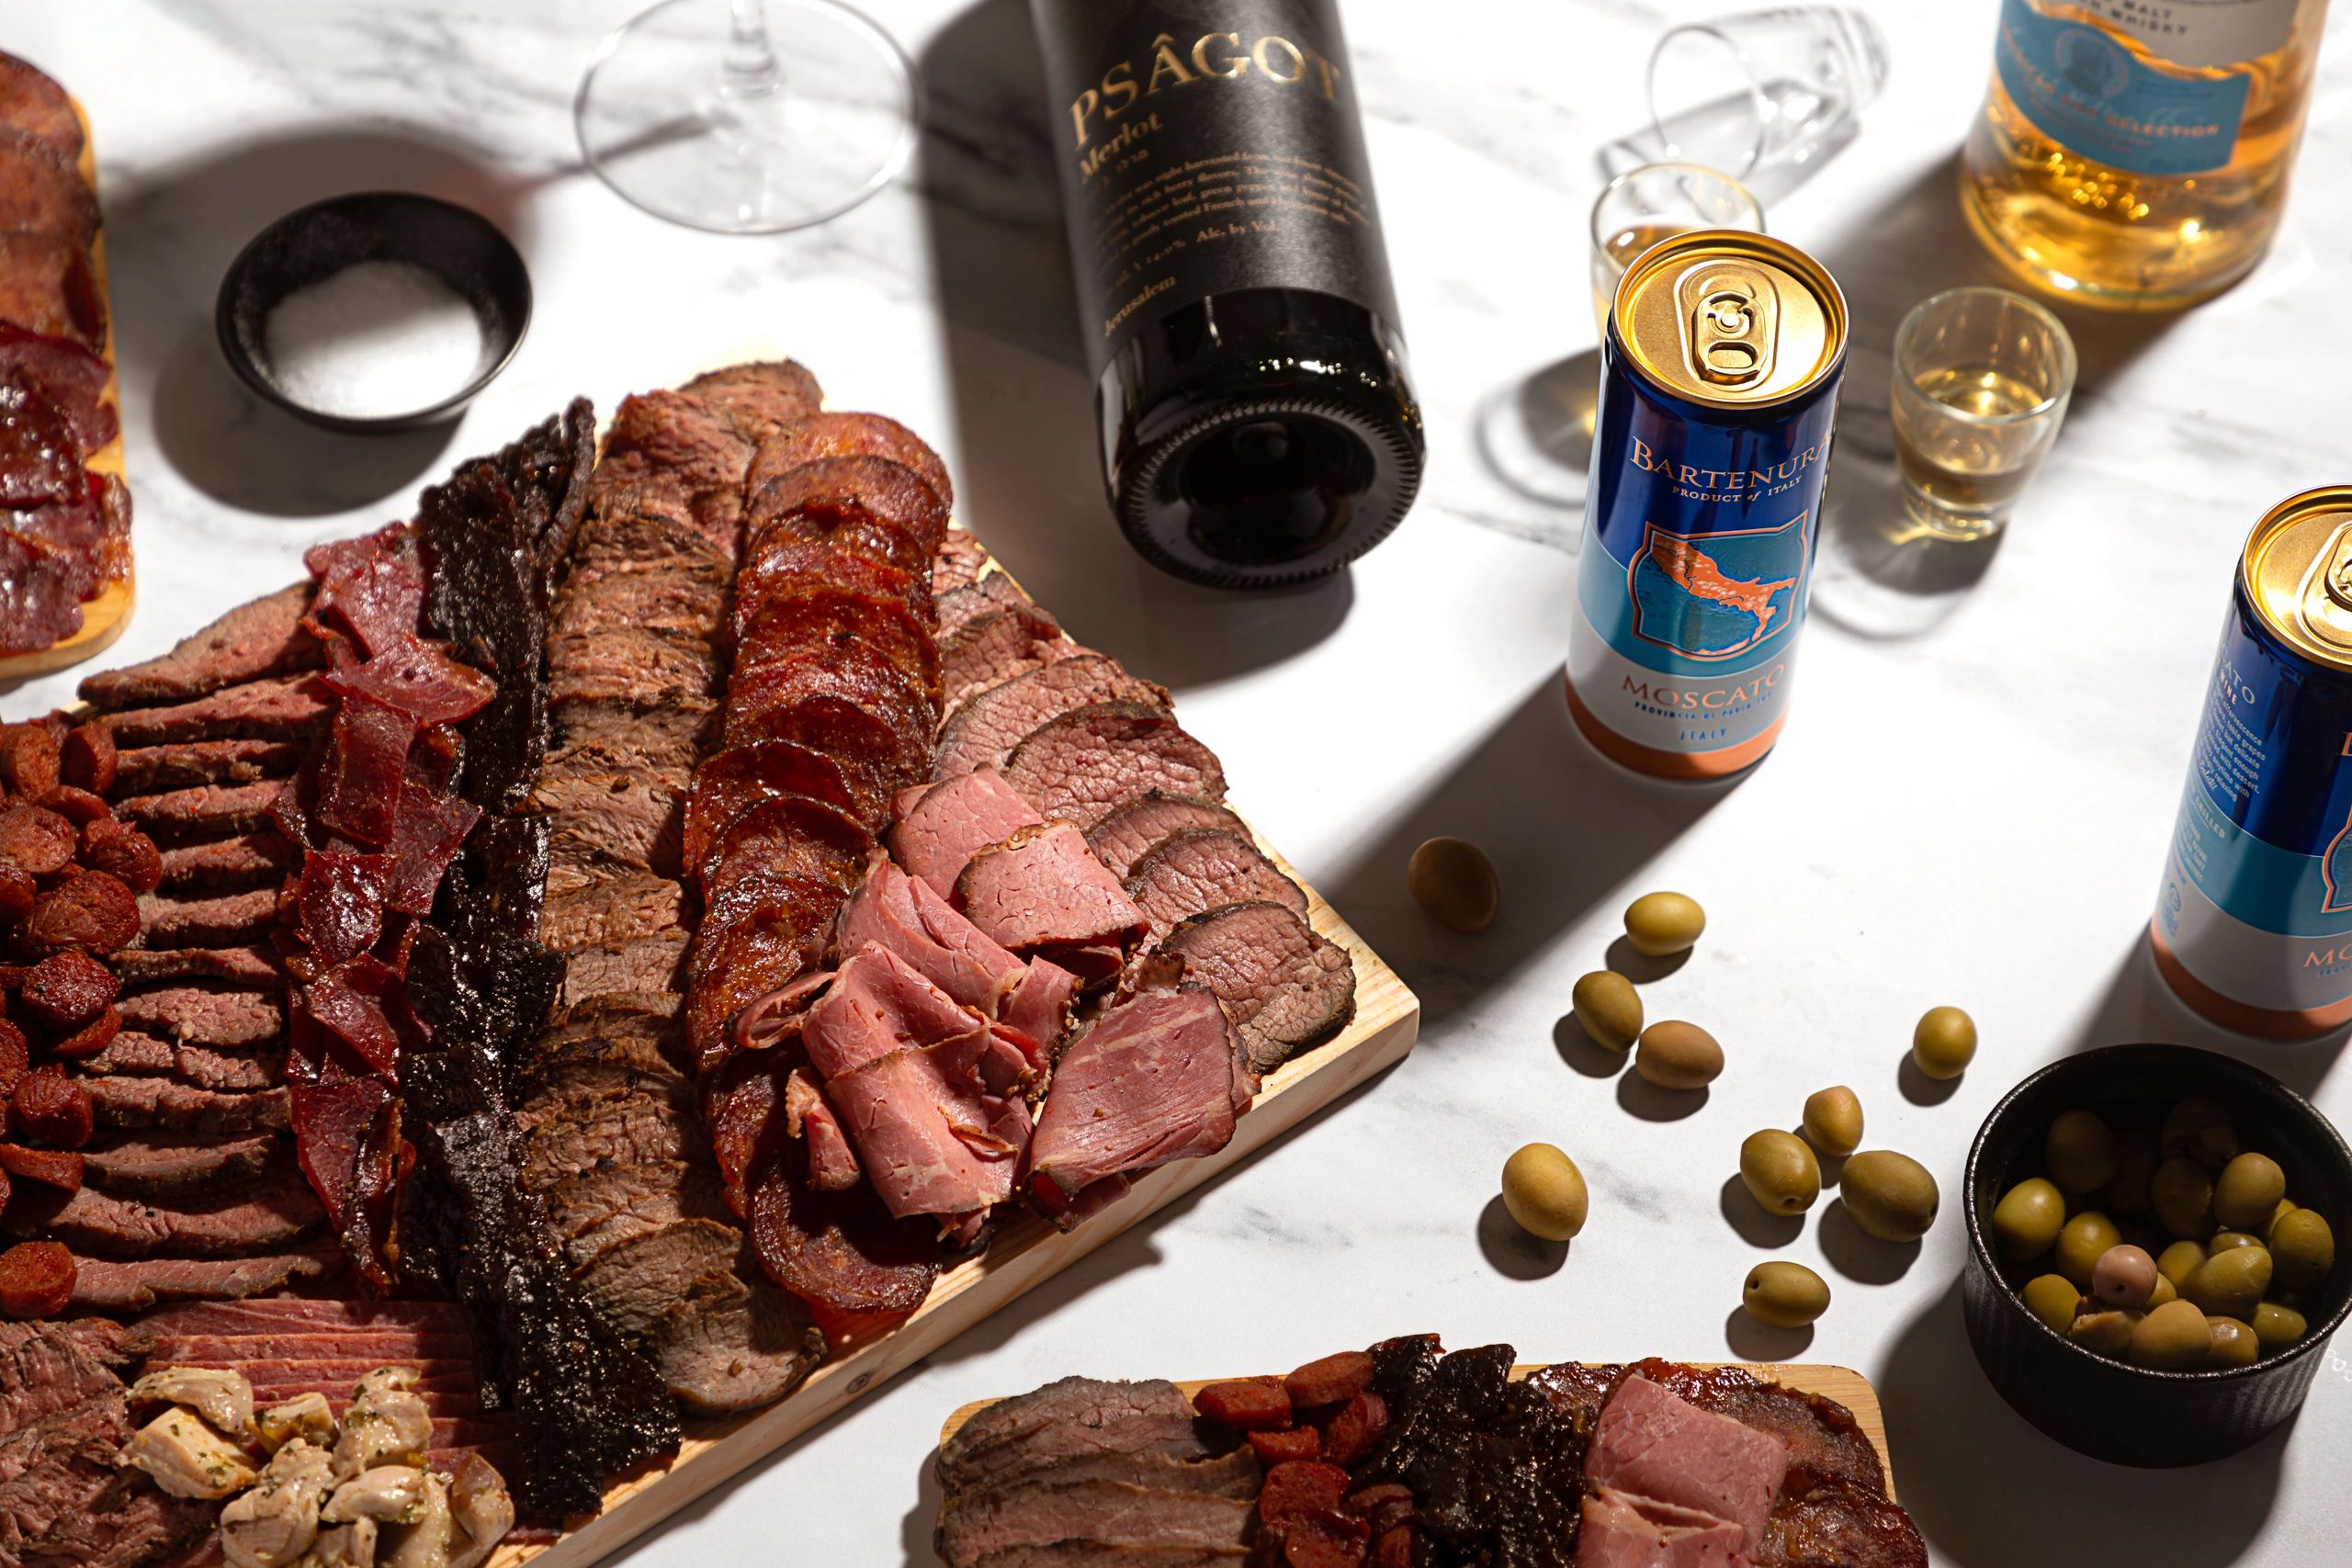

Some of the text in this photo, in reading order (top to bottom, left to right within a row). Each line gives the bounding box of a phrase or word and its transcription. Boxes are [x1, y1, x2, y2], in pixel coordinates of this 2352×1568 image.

[1069, 32, 1340, 152] PSÂGOT
[1080, 111, 1164, 185] Merlot
[1195, 226, 1226, 243] Alc.
[1228, 222, 1247, 237] by
[1104, 276, 1178, 338] Jerusalem
[1630, 428, 1831, 490] BARTENURA
[1672, 474, 1804, 503] PRODUCT of ITALY
[1622, 663, 1785, 709] MOSCATO
[1634, 700, 1697, 720] PROVINCIA
[1680, 727, 1727, 741] ITALY
[2233, 743, 2261, 770] delicate
[2242, 739, 2266, 761] grapes
[2233, 756, 2259, 781] enough
[2233, 782, 2250, 798] with
